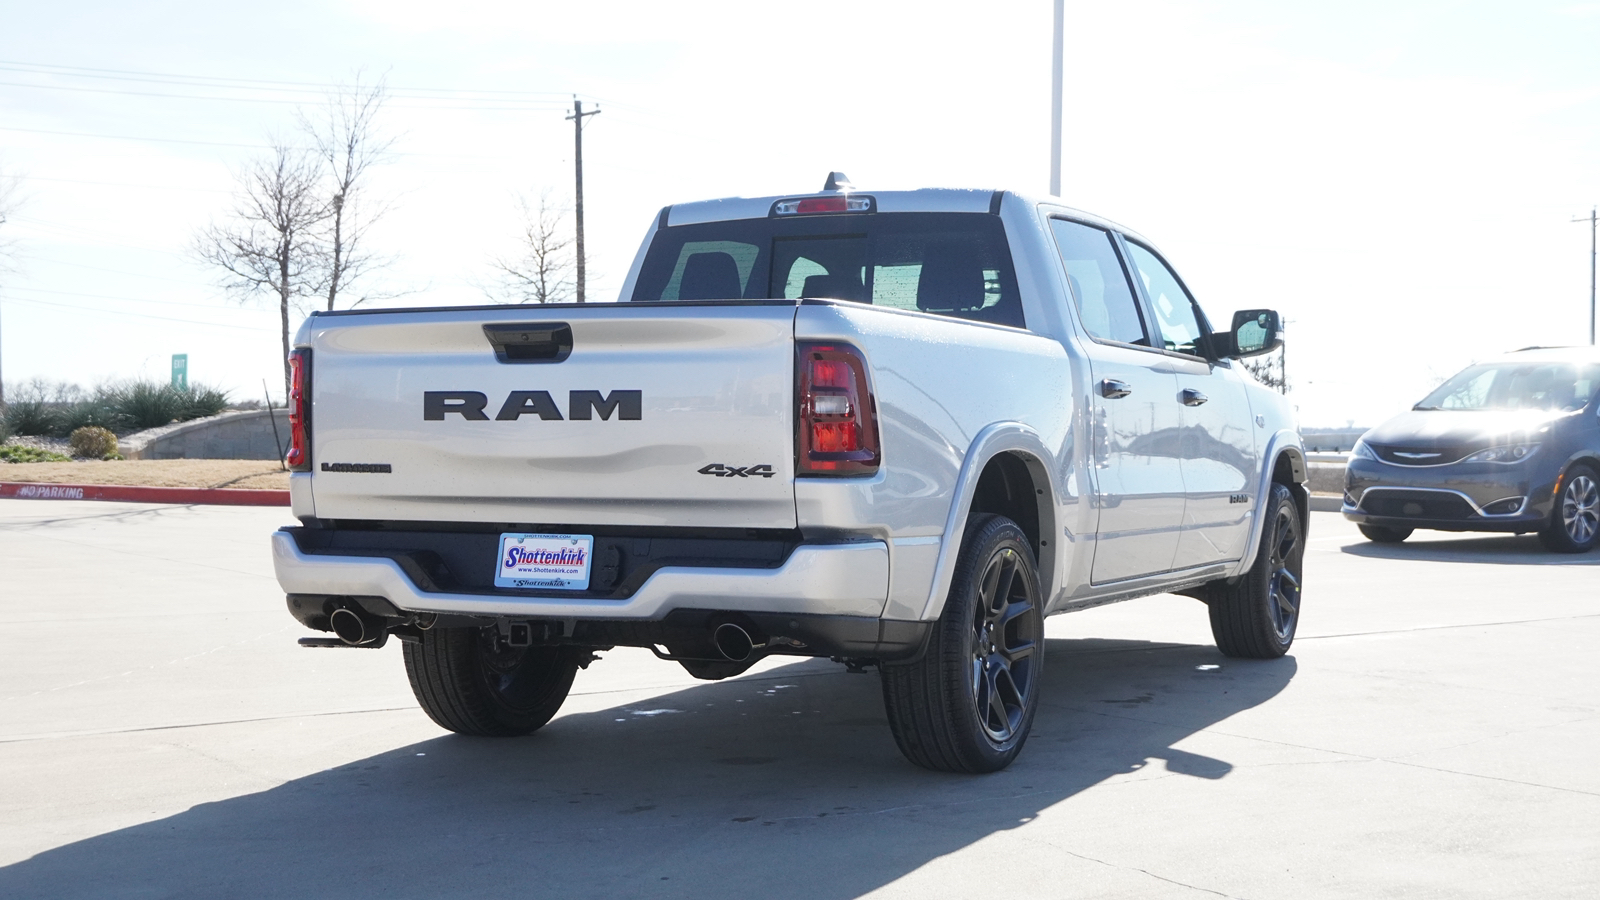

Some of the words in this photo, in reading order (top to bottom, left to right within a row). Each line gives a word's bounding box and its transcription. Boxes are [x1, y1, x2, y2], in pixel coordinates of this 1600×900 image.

[174, 359, 185, 369] EXIT
[424, 390, 642, 421] RAM
[697, 463, 776, 478] 4x4
[20, 485, 36, 496] NO
[37, 486, 84, 499] PARKING
[1229, 495, 1248, 504] RAM
[505, 546, 586, 568] Shottenkirk
[516, 579, 566, 587] Shottenkirk
